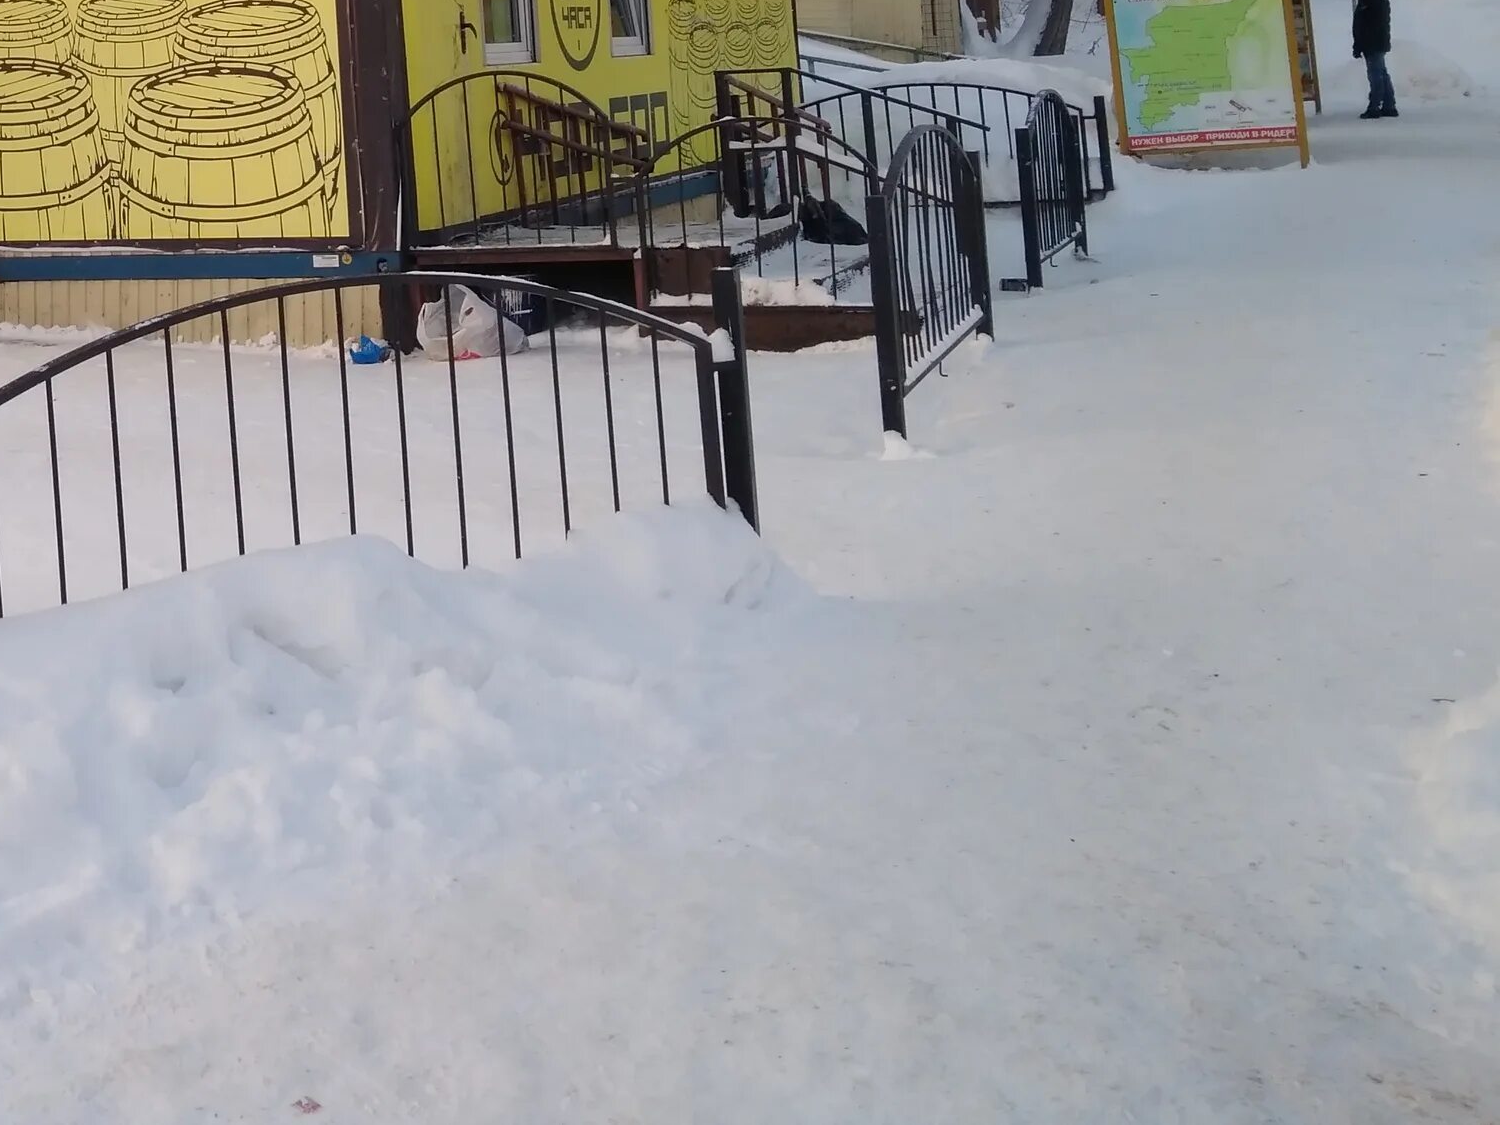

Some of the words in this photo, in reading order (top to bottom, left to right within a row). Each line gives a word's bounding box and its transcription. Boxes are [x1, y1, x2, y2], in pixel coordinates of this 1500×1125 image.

[562, 5, 593, 29] ЧАСА
[1132, 137, 1163, 146] НУЖЕН
[1165, 134, 1199, 144] ВЫБОР
[1206, 131, 1250, 141] ПРИХОДИ
[1260, 128, 1295, 139] РИДЕР!
